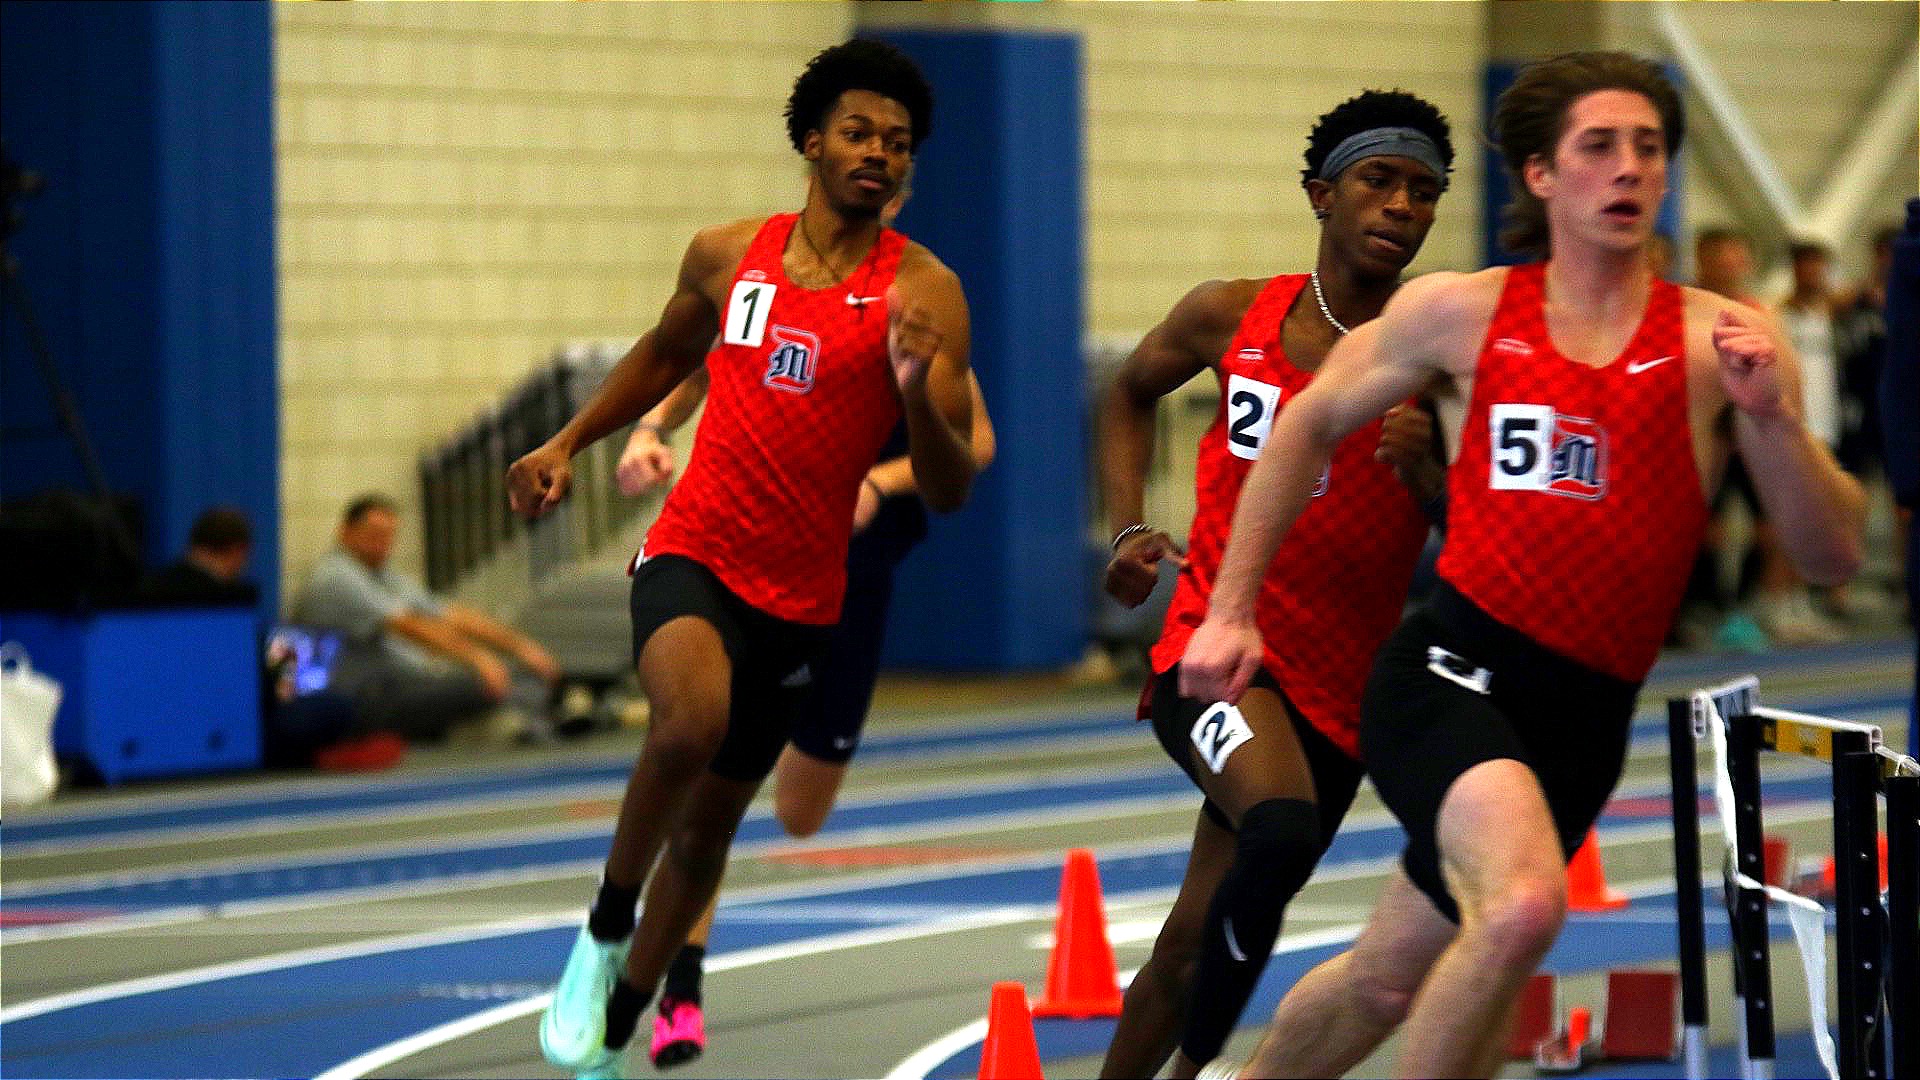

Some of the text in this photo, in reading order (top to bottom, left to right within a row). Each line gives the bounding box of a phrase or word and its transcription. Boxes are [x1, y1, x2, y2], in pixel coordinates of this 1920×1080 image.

[742, 286, 761, 340] 1
[1229, 390, 1263, 449] 2
[1499, 417, 1538, 476] 5
[1201, 710, 1238, 760] 2
